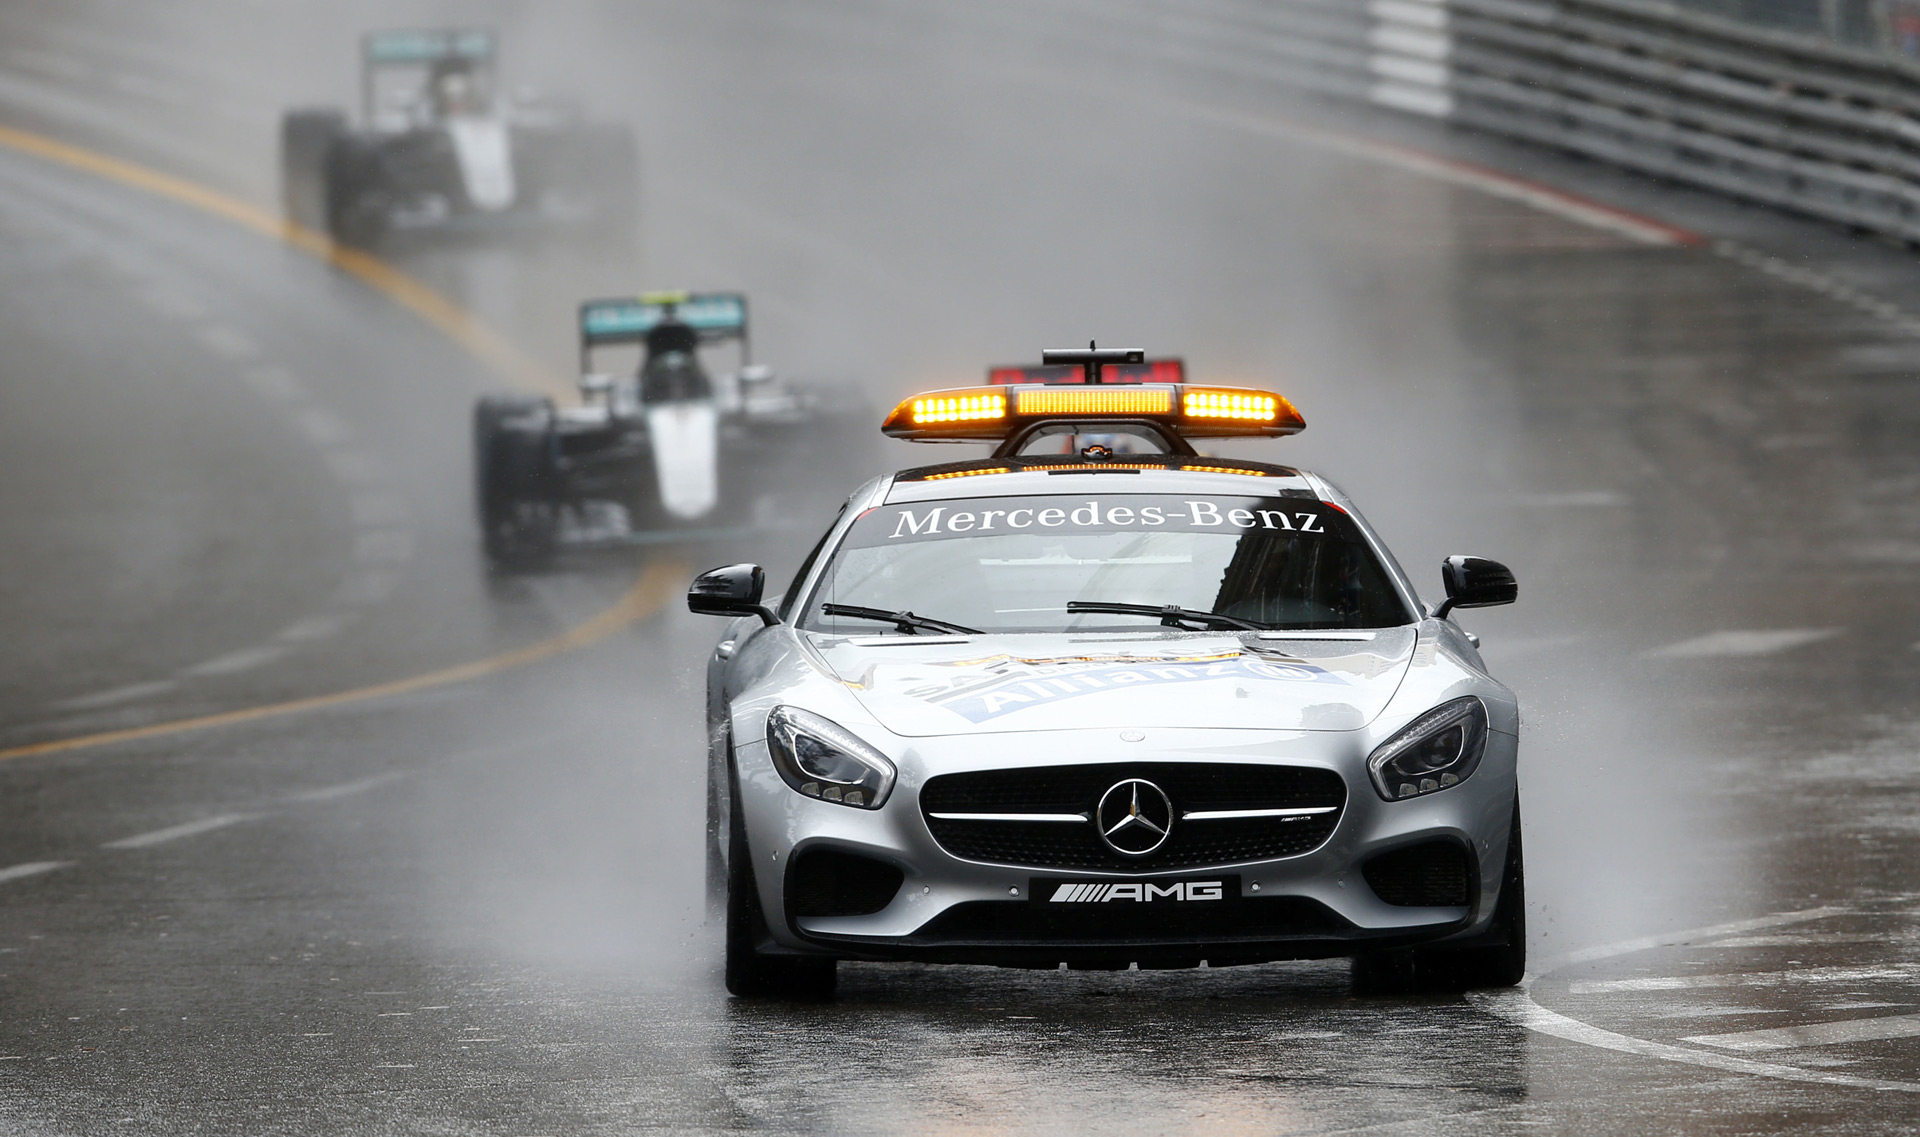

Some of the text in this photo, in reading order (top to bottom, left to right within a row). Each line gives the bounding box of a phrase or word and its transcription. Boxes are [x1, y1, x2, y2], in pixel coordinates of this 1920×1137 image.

[889, 501, 1325, 538] Mercedes-Benz
[975, 662, 1239, 714] Allianz
[1101, 881, 1222, 902] AMG
